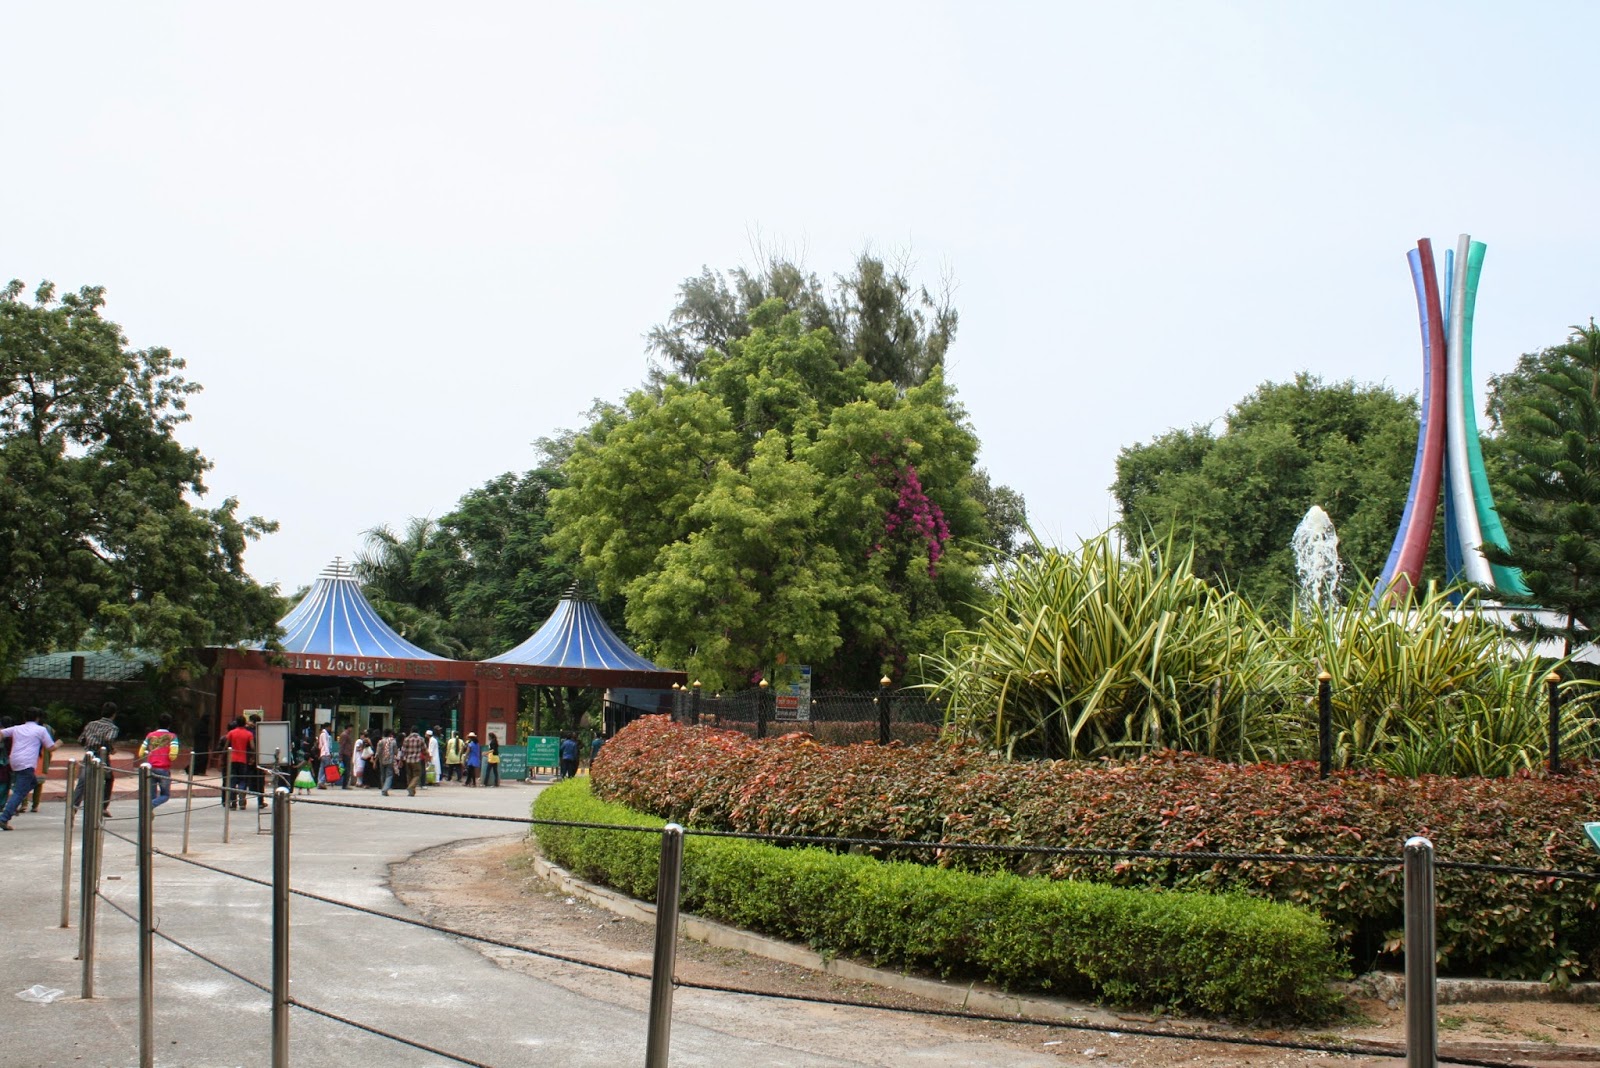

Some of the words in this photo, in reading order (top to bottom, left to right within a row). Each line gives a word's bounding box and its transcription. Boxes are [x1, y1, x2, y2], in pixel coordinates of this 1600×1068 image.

[286, 655, 321, 670] ehru
[327, 657, 401, 675] Zoological
[405, 661, 438, 675] Park
